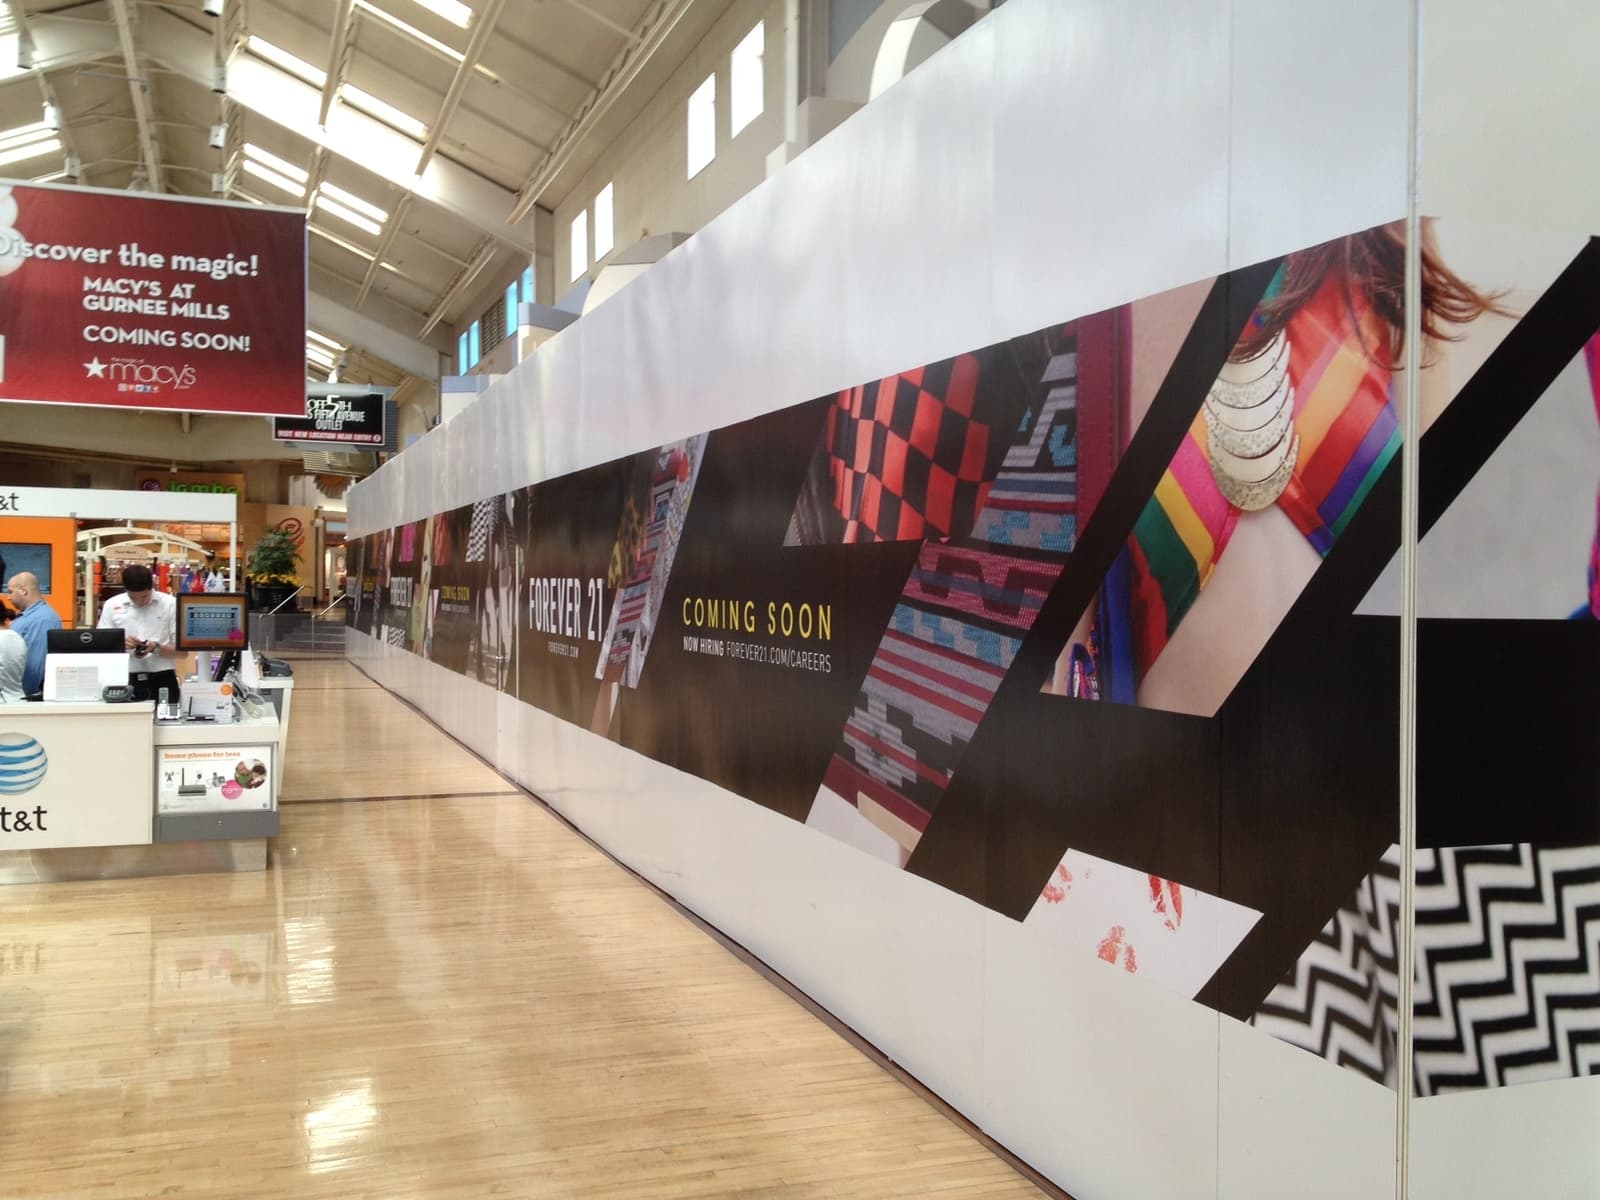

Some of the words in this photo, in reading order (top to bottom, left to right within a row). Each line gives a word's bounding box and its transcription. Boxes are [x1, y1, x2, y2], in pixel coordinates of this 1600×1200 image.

[118, 243, 165, 269] the
[171, 253, 259, 280] magic!
[83, 276, 162, 297] MACY'S
[170, 283, 196, 299] AT
[83, 295, 168, 316] GURNEE
[171, 302, 231, 320] MILLS
[83, 325, 177, 346] COMING
[180, 332, 251, 352] SOON!
[529, 577, 581, 639] FOREVER
[587, 577, 604, 642] 21
[682, 597, 756, 633] COMING
[768, 601, 832, 641] SOON
[683, 636, 698, 652] NOW
[700, 637, 724, 657] HIRING
[726, 640, 832, 673] FOREVER21.COM/CAREERS
